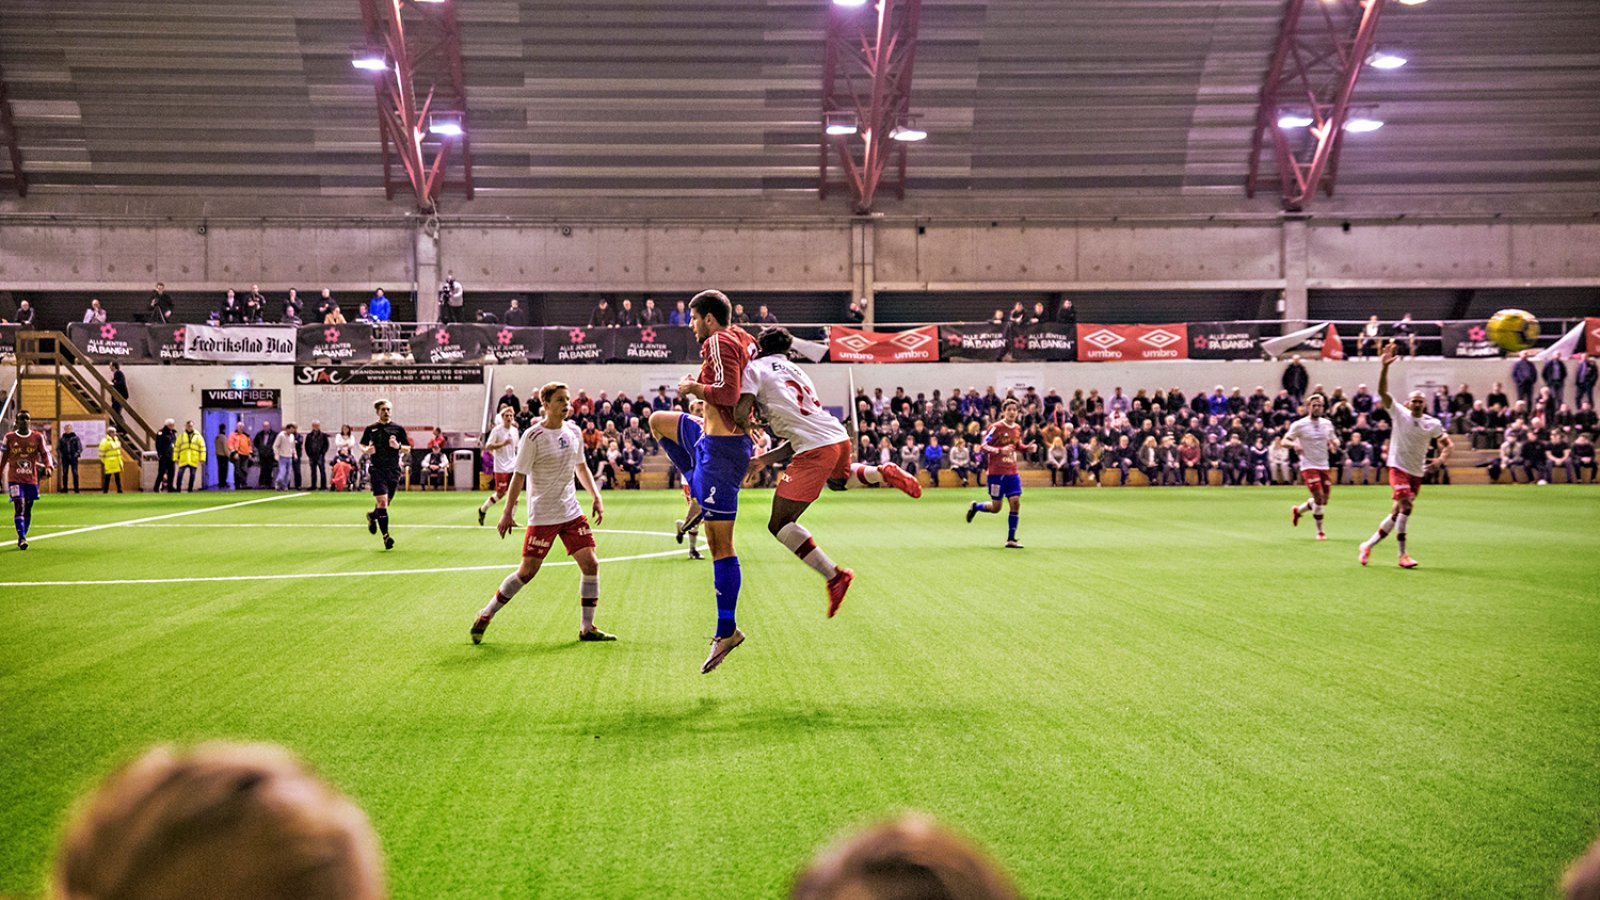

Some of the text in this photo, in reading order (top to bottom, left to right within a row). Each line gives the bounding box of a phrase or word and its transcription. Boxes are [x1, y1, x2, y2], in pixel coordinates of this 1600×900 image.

[266, 337, 294, 355] Blad
[570, 349, 600, 359] BANEN
[839, 351, 874, 360] umbro
[894, 350, 929, 359] umbro
[1087, 349, 1122, 358] umbro
[1142, 348, 1178, 357] umbro
[297, 366, 342, 384] STAC
